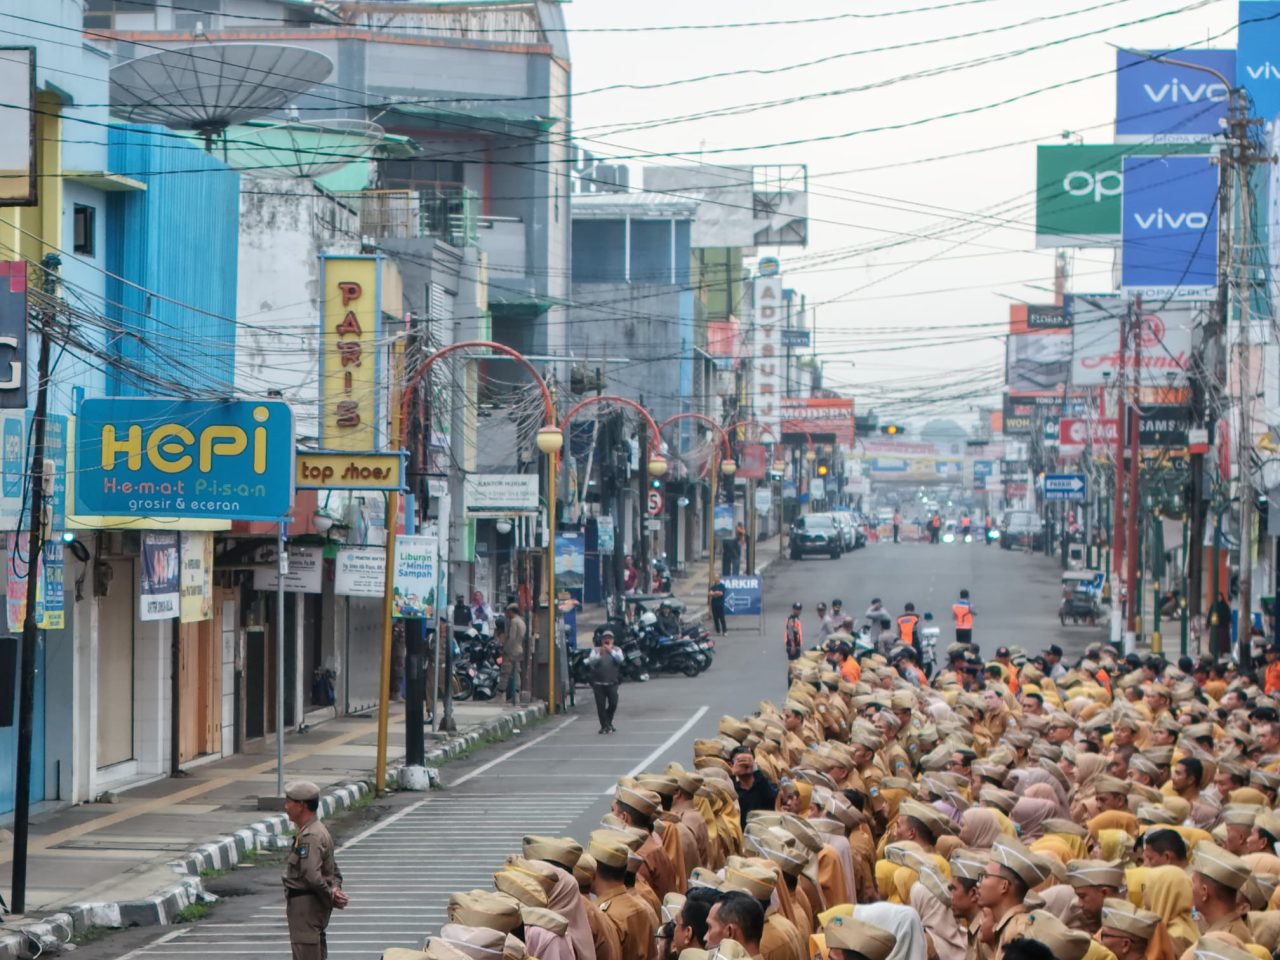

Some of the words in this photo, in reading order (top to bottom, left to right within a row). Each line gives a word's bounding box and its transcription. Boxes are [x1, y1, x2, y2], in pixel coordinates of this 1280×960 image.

[1247, 62, 1280, 79] viv
[1144, 78, 1231, 102] vivo
[1064, 170, 1123, 203] op
[1134, 208, 1208, 229] vivo
[336, 282, 362, 428] PARIS
[783, 408, 851, 419] MODERN
[302, 462, 334, 483] top
[341, 464, 392, 481] shoes
[128, 498, 174, 512] grosir
[176, 498, 185, 510] &
[191, 500, 239, 511] eceran
[400, 552, 432, 561] Liburan
[407, 561, 432, 570] Minim
[398, 569, 432, 580] Sampah
